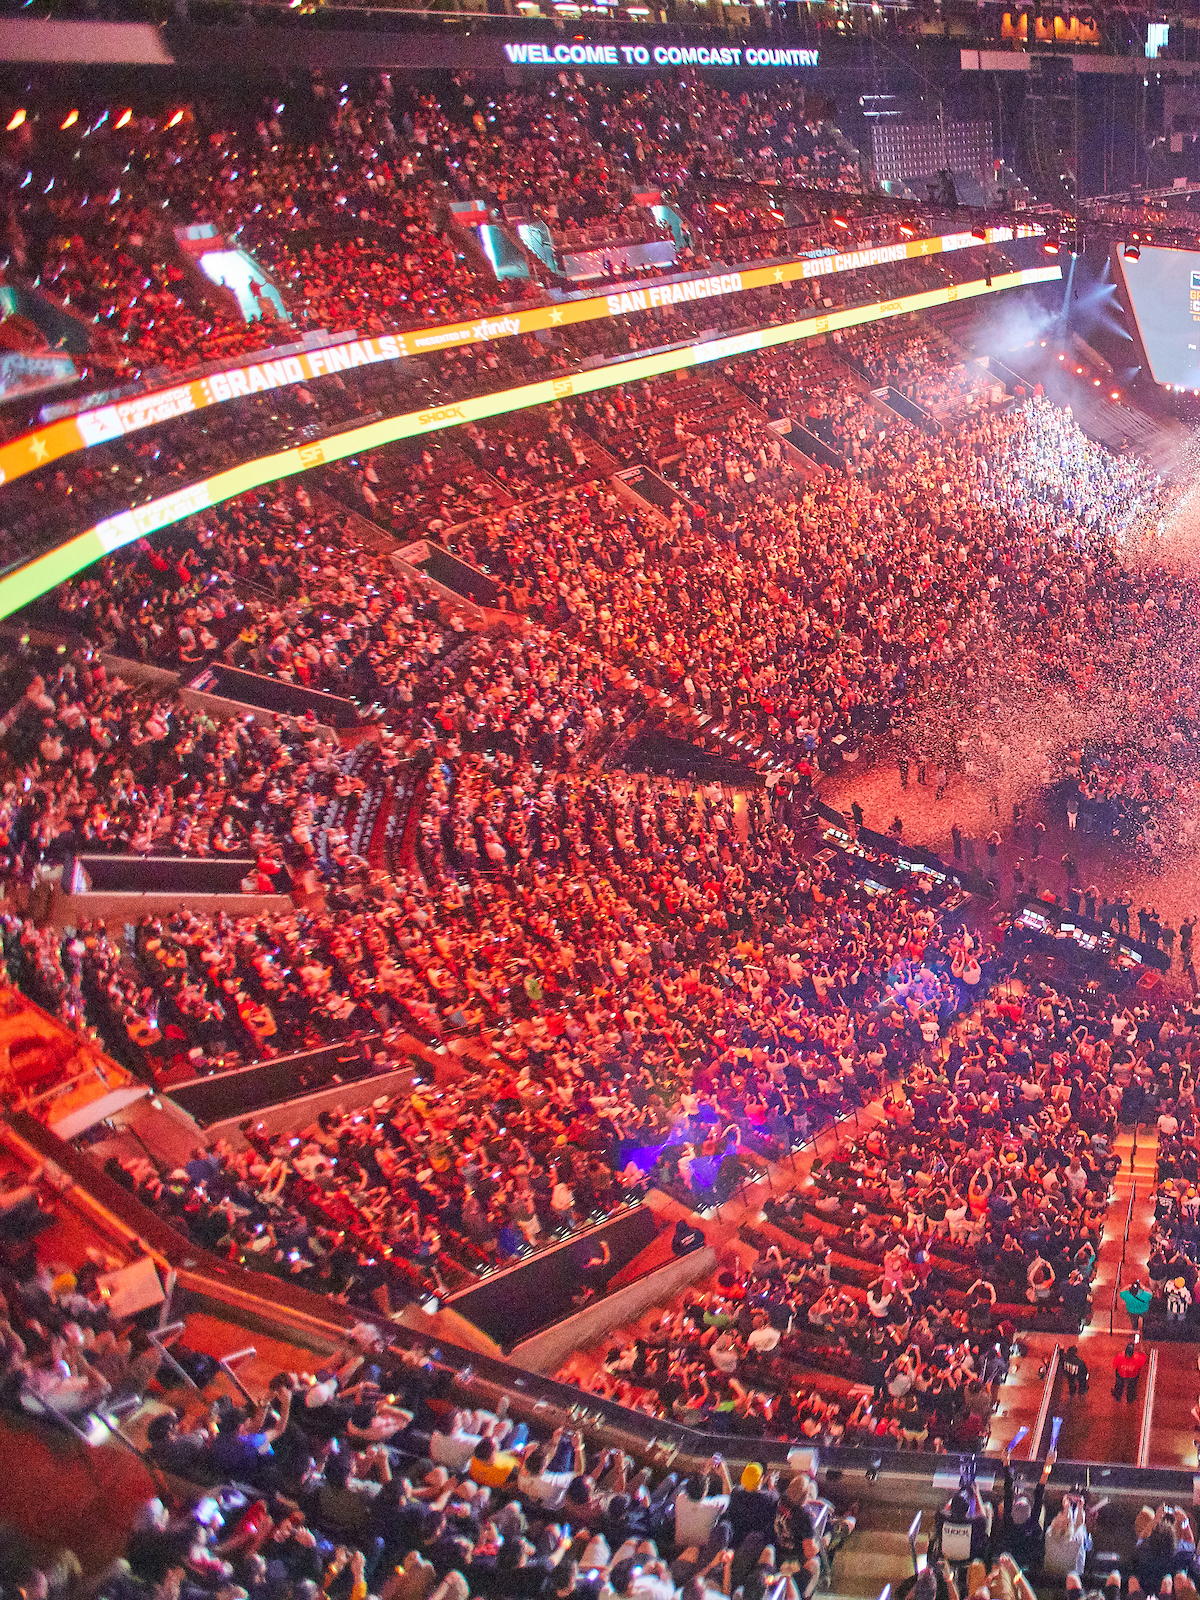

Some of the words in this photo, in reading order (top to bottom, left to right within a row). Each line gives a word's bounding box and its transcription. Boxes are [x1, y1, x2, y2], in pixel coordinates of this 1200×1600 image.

[504, 43, 619, 64] WELCOME
[621, 46, 650, 65] TO
[654, 47, 741, 66] COMCAST
[746, 49, 819, 66] COUNTRY
[802, 257, 833, 278] 2019
[835, 245, 908, 273] CHAMPIONS!
[606, 290, 646, 316] SAN
[650, 273, 743, 305] FRANCISCO
[880, 302, 903, 312] SHOCK
[472, 318, 521, 341] xfinity
[208, 357, 303, 402] GRAND
[307, 336, 400, 377] FINALS
[118, 386, 191, 416] OVERWATCH
[122, 399, 196, 433] LEAGUE
[418, 405, 466, 427] SHOCK
